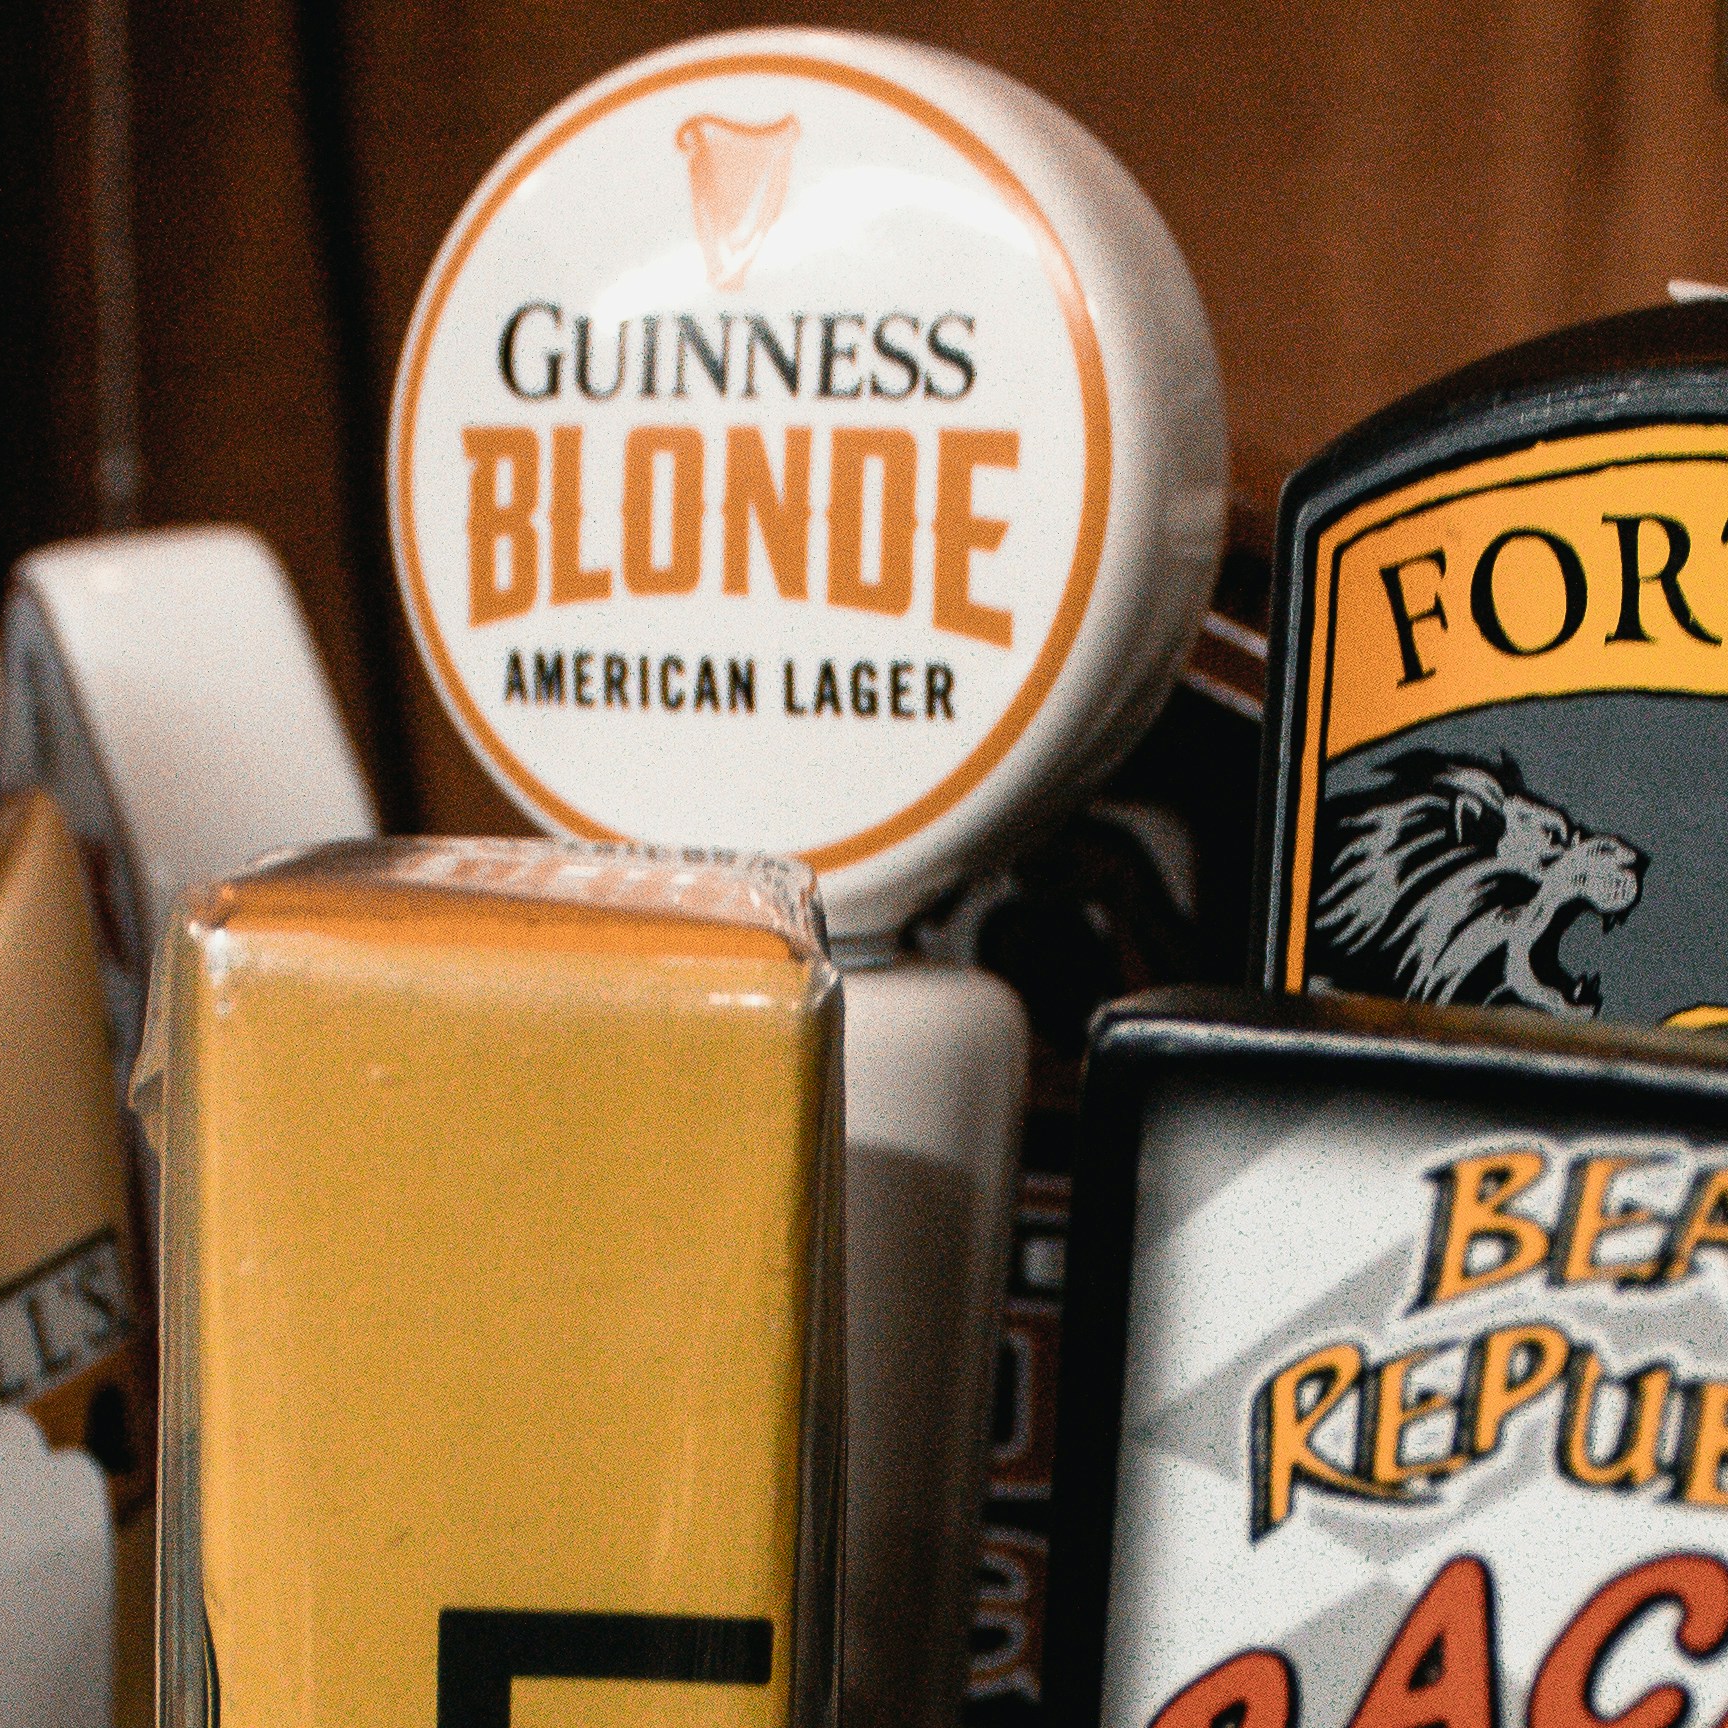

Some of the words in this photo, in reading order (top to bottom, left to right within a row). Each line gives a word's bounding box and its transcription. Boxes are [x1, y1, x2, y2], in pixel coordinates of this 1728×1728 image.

[499, 301, 979, 401] GUINNESS
[460, 424, 1020, 650] BLONDE
[504, 648, 757, 714] AMERICAN
[783, 654, 957, 720] LAGER
